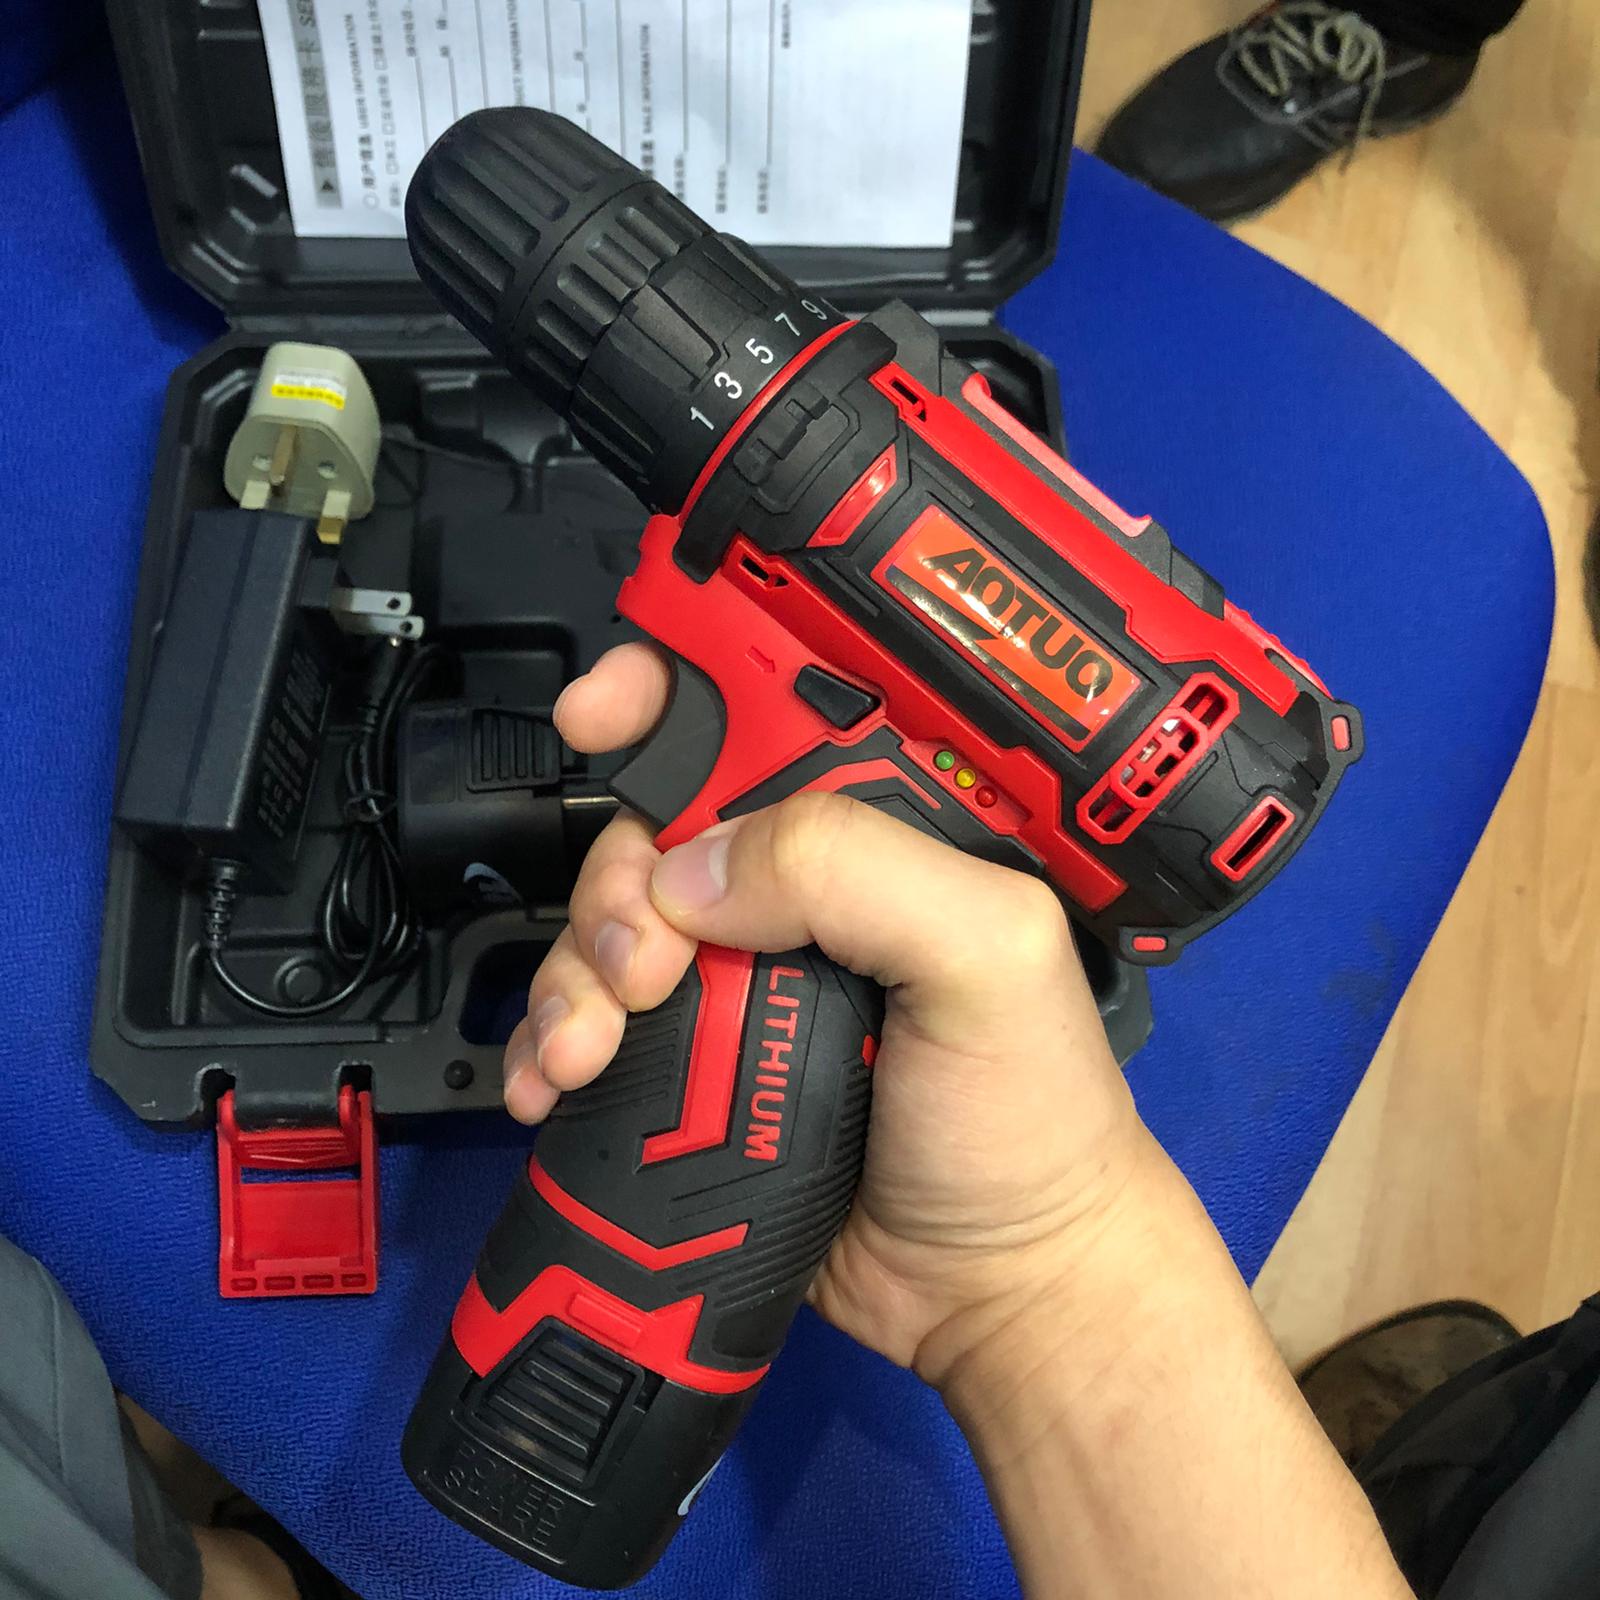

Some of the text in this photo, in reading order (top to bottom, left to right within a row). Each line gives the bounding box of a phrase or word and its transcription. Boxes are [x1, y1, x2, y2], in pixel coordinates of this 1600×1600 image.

[296, 0, 316, 28] SE
[344, 14, 364, 95] INFORMATION
[640, 24, 651, 103] INFORMATION
[690, 299, 828, 430] 1 3 5 7 9
[919, 548, 1114, 702] AOTUO
[744, 965, 804, 1162] LITHIUM
